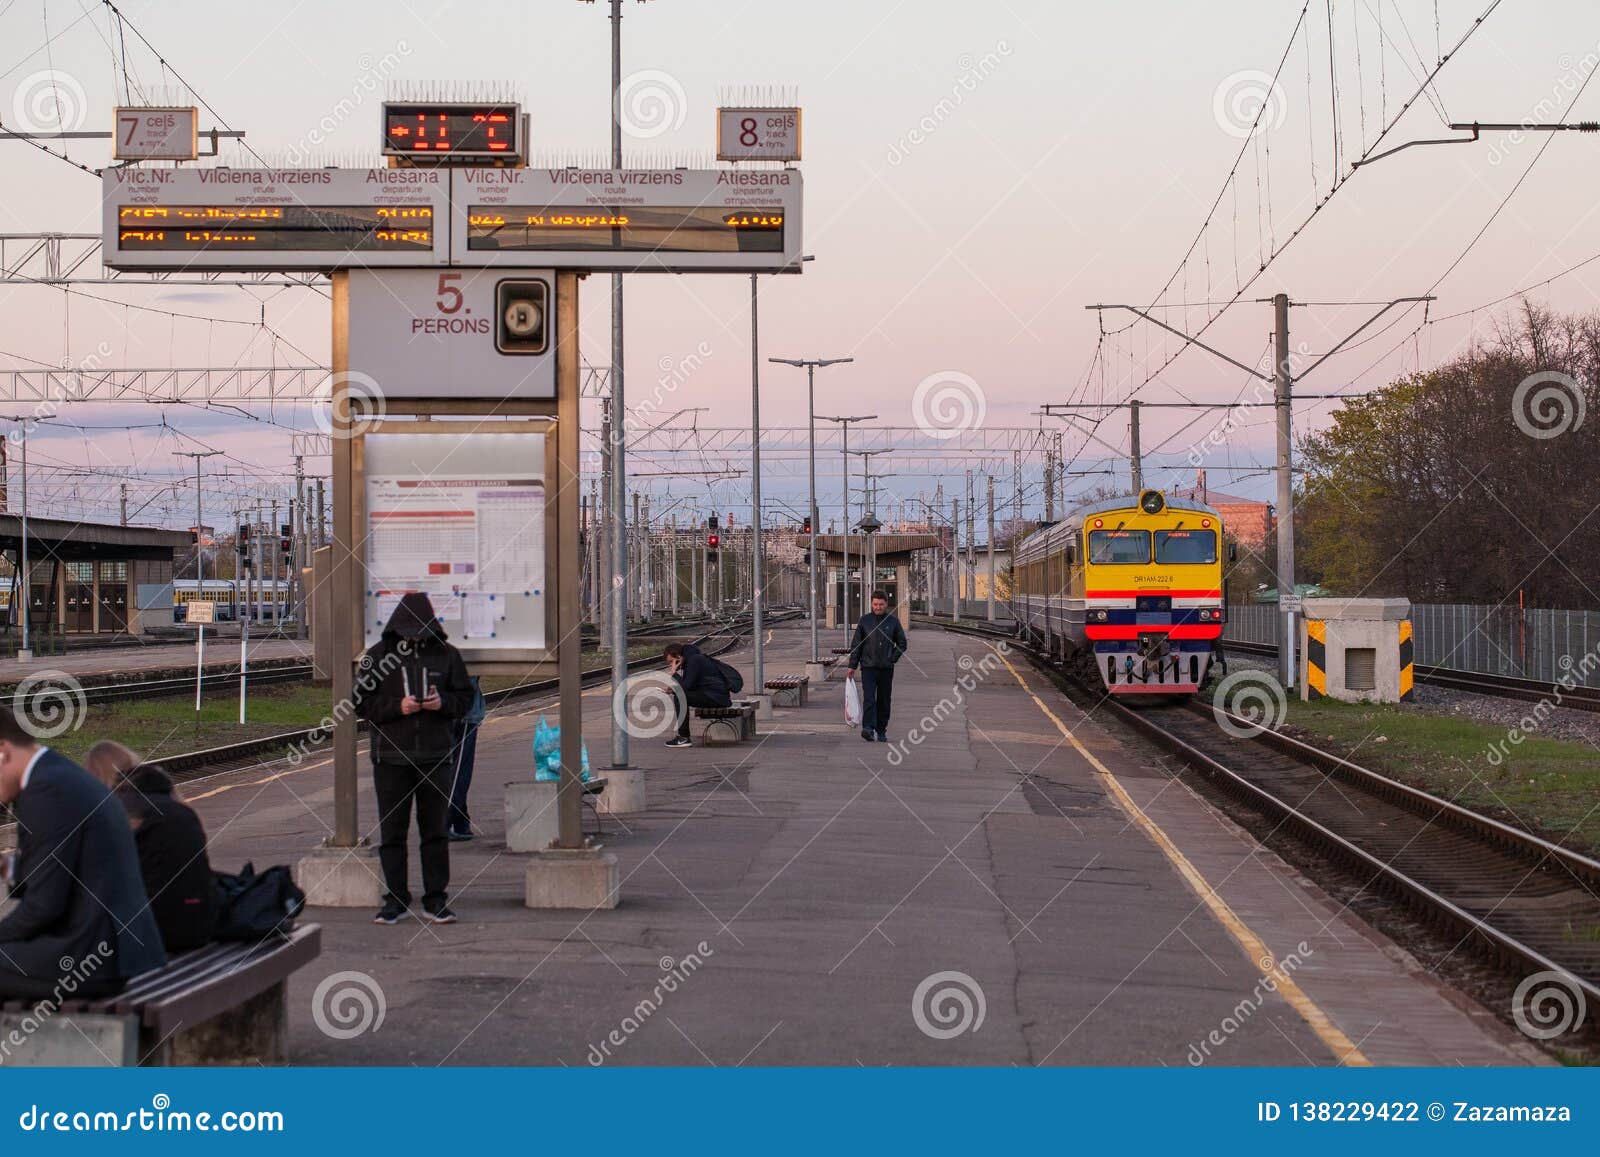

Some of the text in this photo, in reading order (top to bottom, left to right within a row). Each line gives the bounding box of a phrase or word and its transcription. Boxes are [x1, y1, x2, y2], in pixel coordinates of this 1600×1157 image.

[115, 168, 439, 184] Vilc.Nr. Vilciena virziens Atiešana
[464, 169, 790, 185] Vilc.Nr. Vilciena virziens Atiešana
[436, 273, 471, 314] 5.
[411, 318, 490, 334] PERONS
